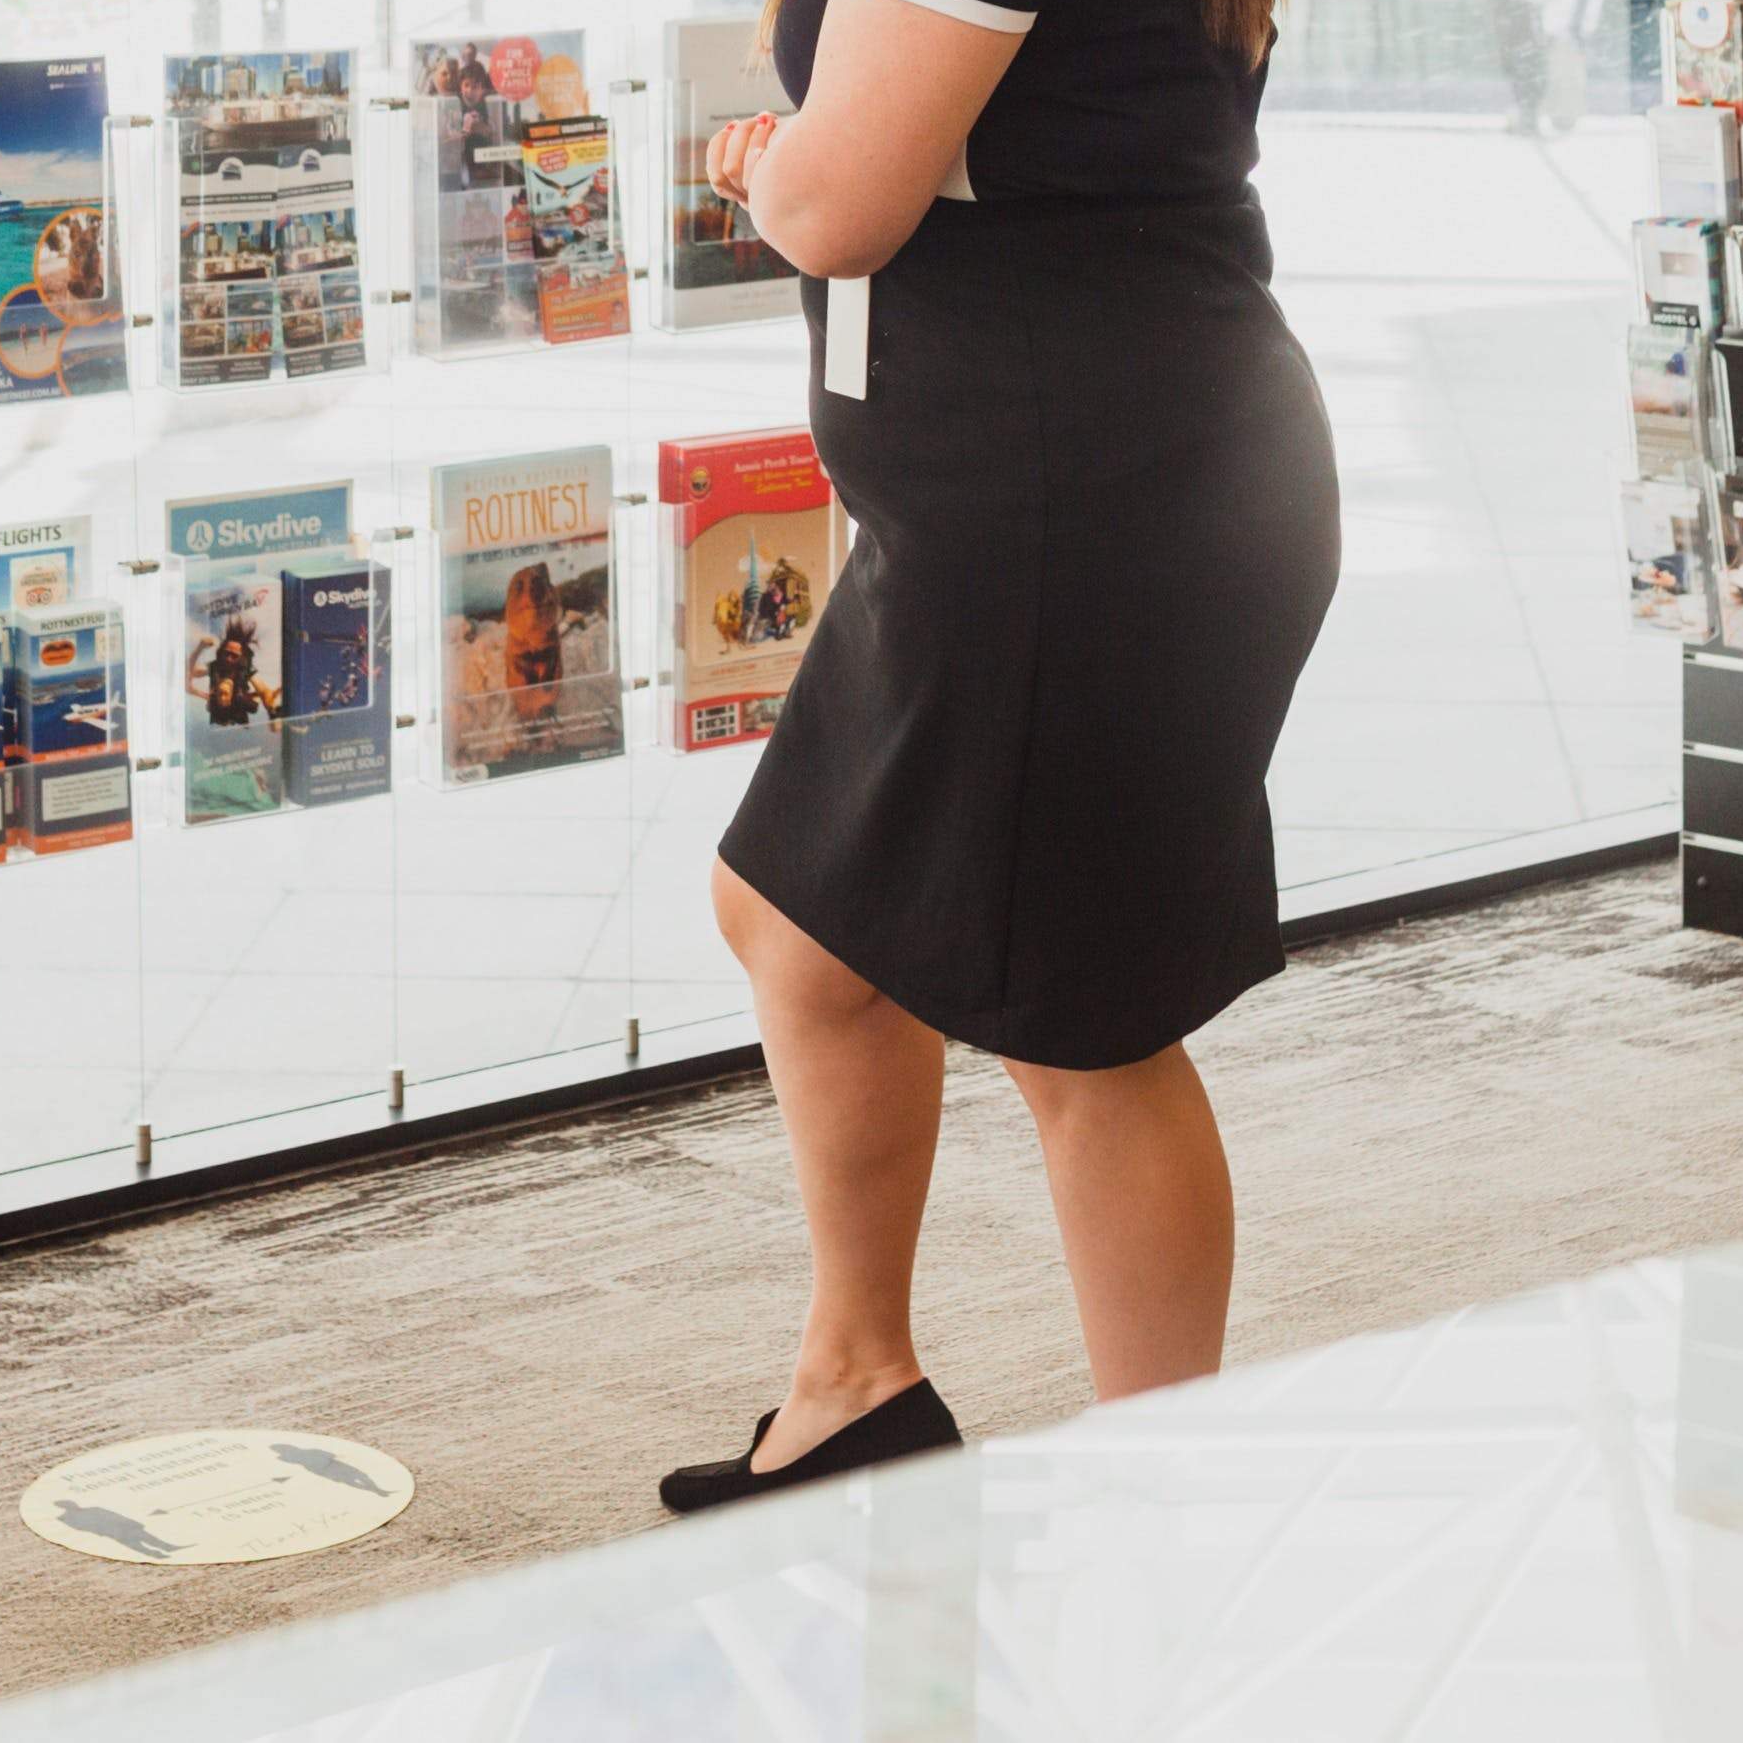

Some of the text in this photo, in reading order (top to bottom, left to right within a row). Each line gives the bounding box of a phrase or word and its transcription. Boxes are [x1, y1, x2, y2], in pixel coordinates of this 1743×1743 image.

[1653, 313, 1687, 325] HOSTEL
[466, 482, 588, 546] ROTTNEST
[218, 512, 322, 551] Skydive
[41, 617, 85, 630] ROTTNEST
[321, 744, 375, 762] LEARN TO
